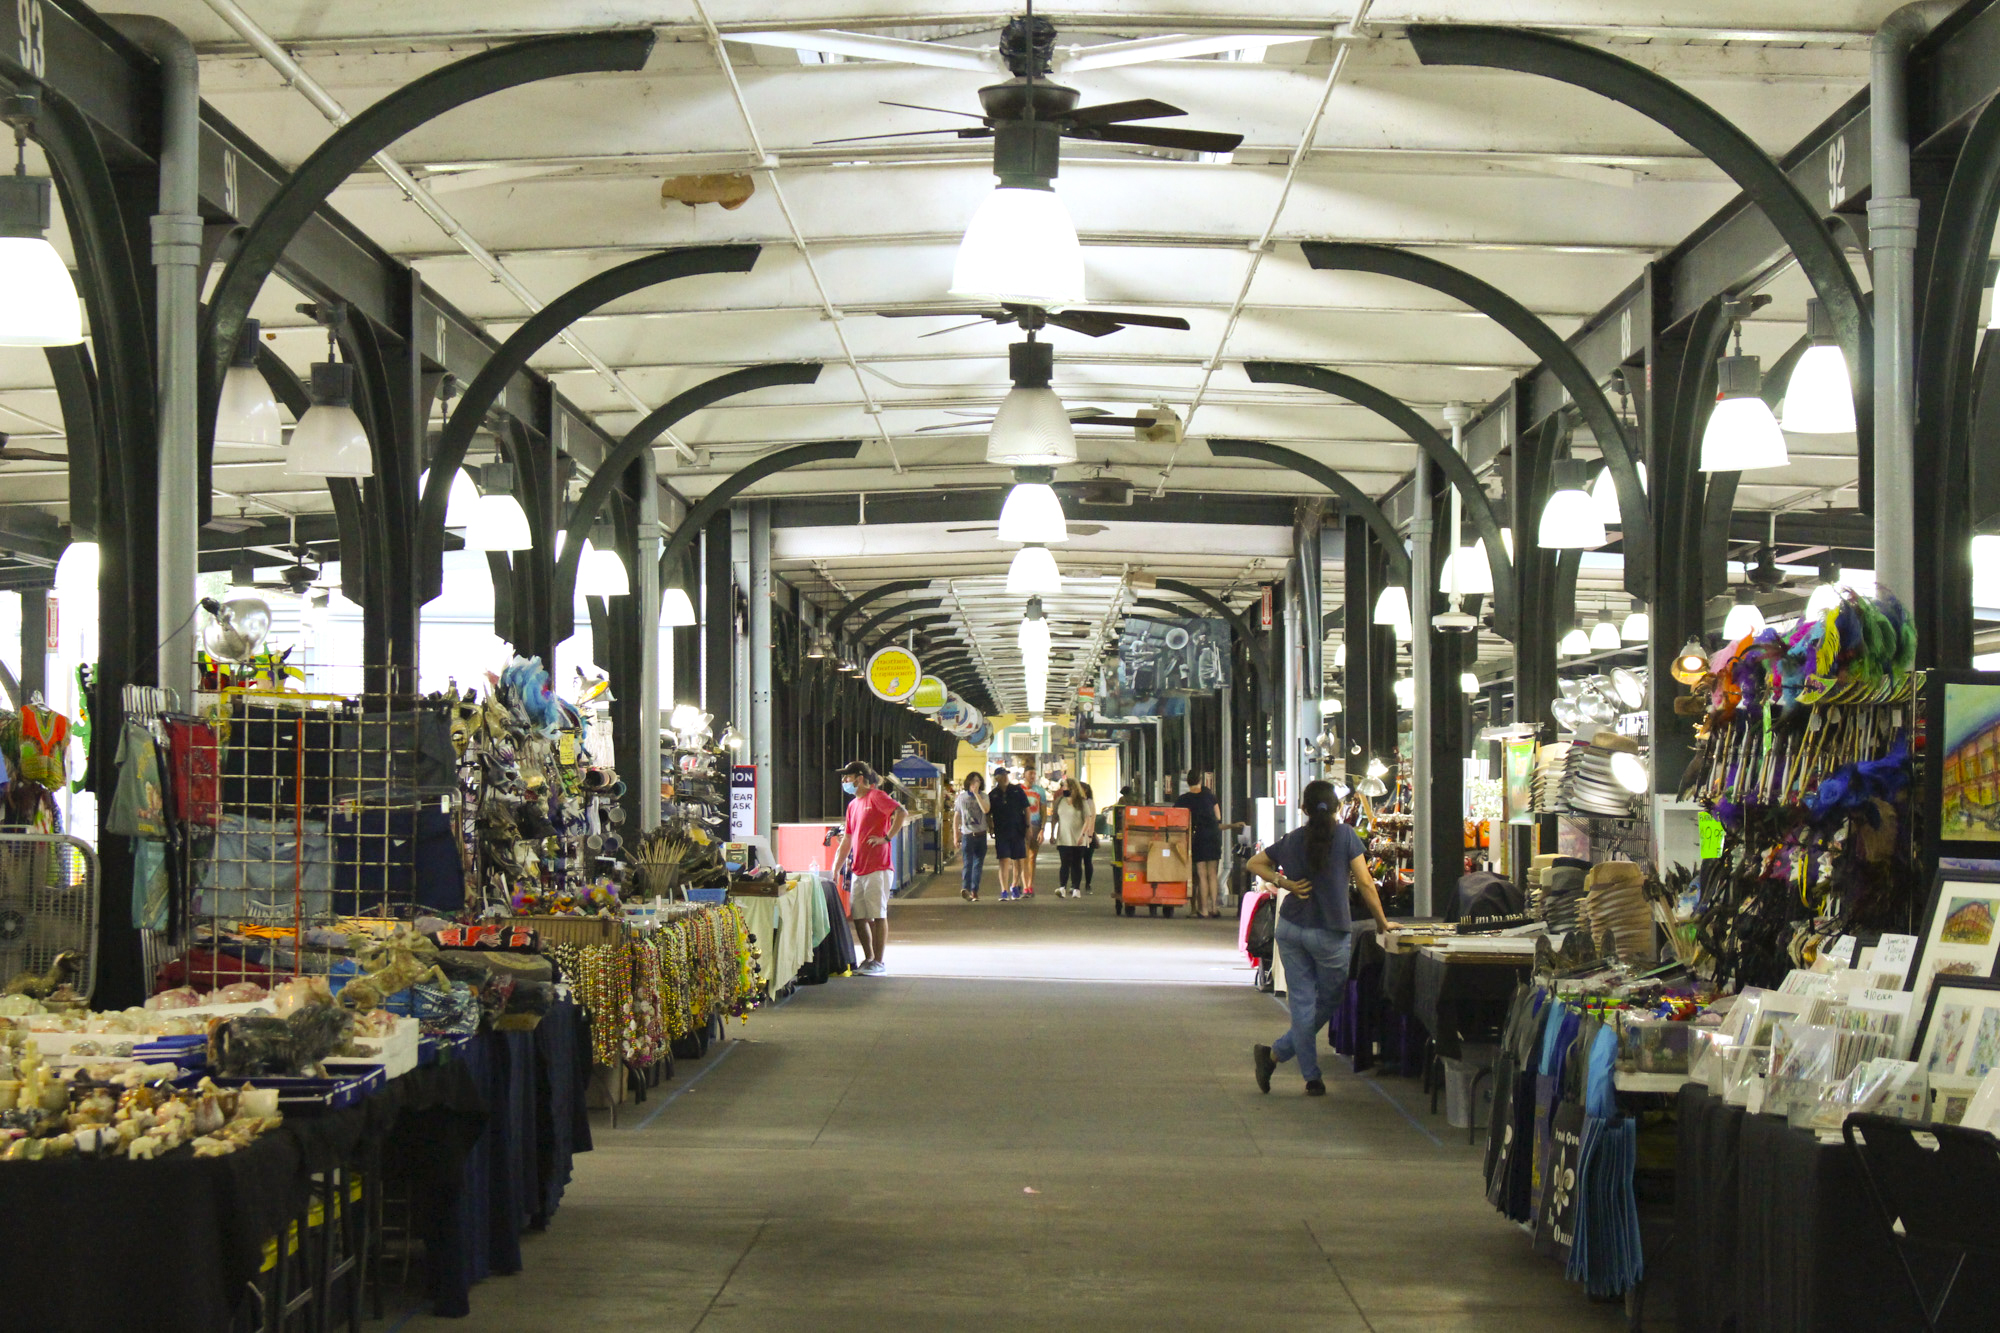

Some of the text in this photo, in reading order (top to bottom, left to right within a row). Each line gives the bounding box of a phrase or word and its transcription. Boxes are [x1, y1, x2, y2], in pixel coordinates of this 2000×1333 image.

[18, 0, 45, 79] 93
[224, 150, 238, 218] 91
[1829, 135, 1845, 209] 92
[1622, 308, 1632, 361] 88
